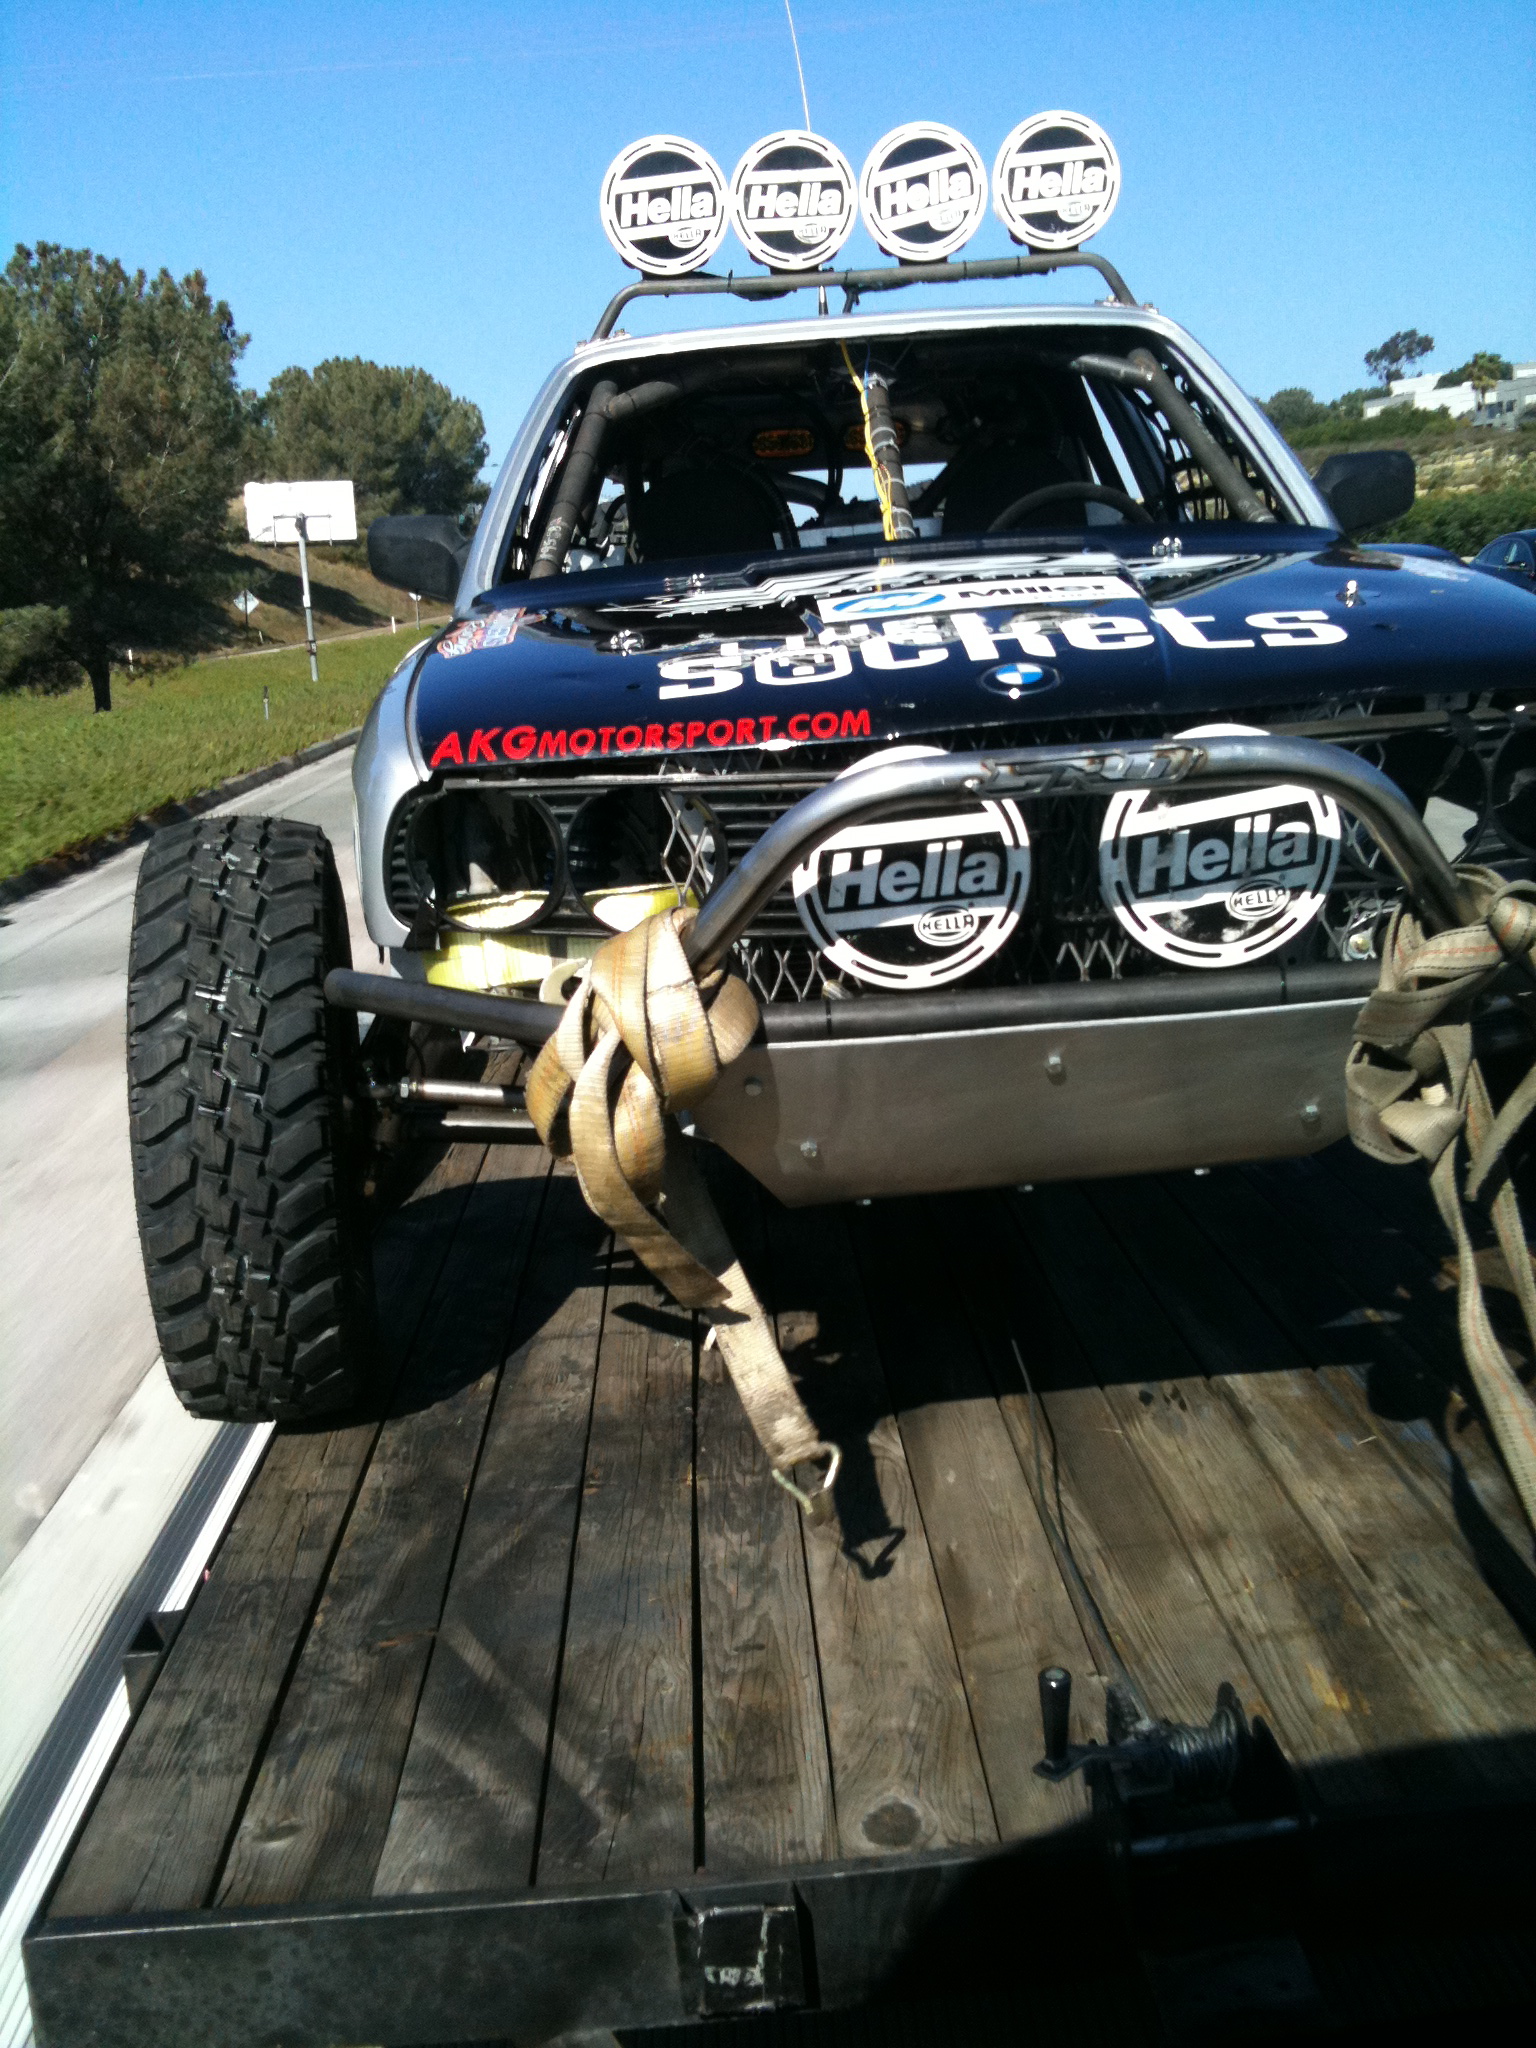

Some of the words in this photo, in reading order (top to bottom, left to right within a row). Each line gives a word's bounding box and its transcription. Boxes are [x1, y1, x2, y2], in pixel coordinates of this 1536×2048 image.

[749, 182, 842, 219] Hella
[880, 168, 971, 220] Hella
[1011, 160, 1106, 202] Hella
[620, 185, 714, 228] Hella
[430, 709, 871, 767] AKGMOTORSPORT.COM
[828, 839, 1001, 909] Hella
[1138, 813, 1311, 894] Hella
[922, 913, 975, 931] HELLA
